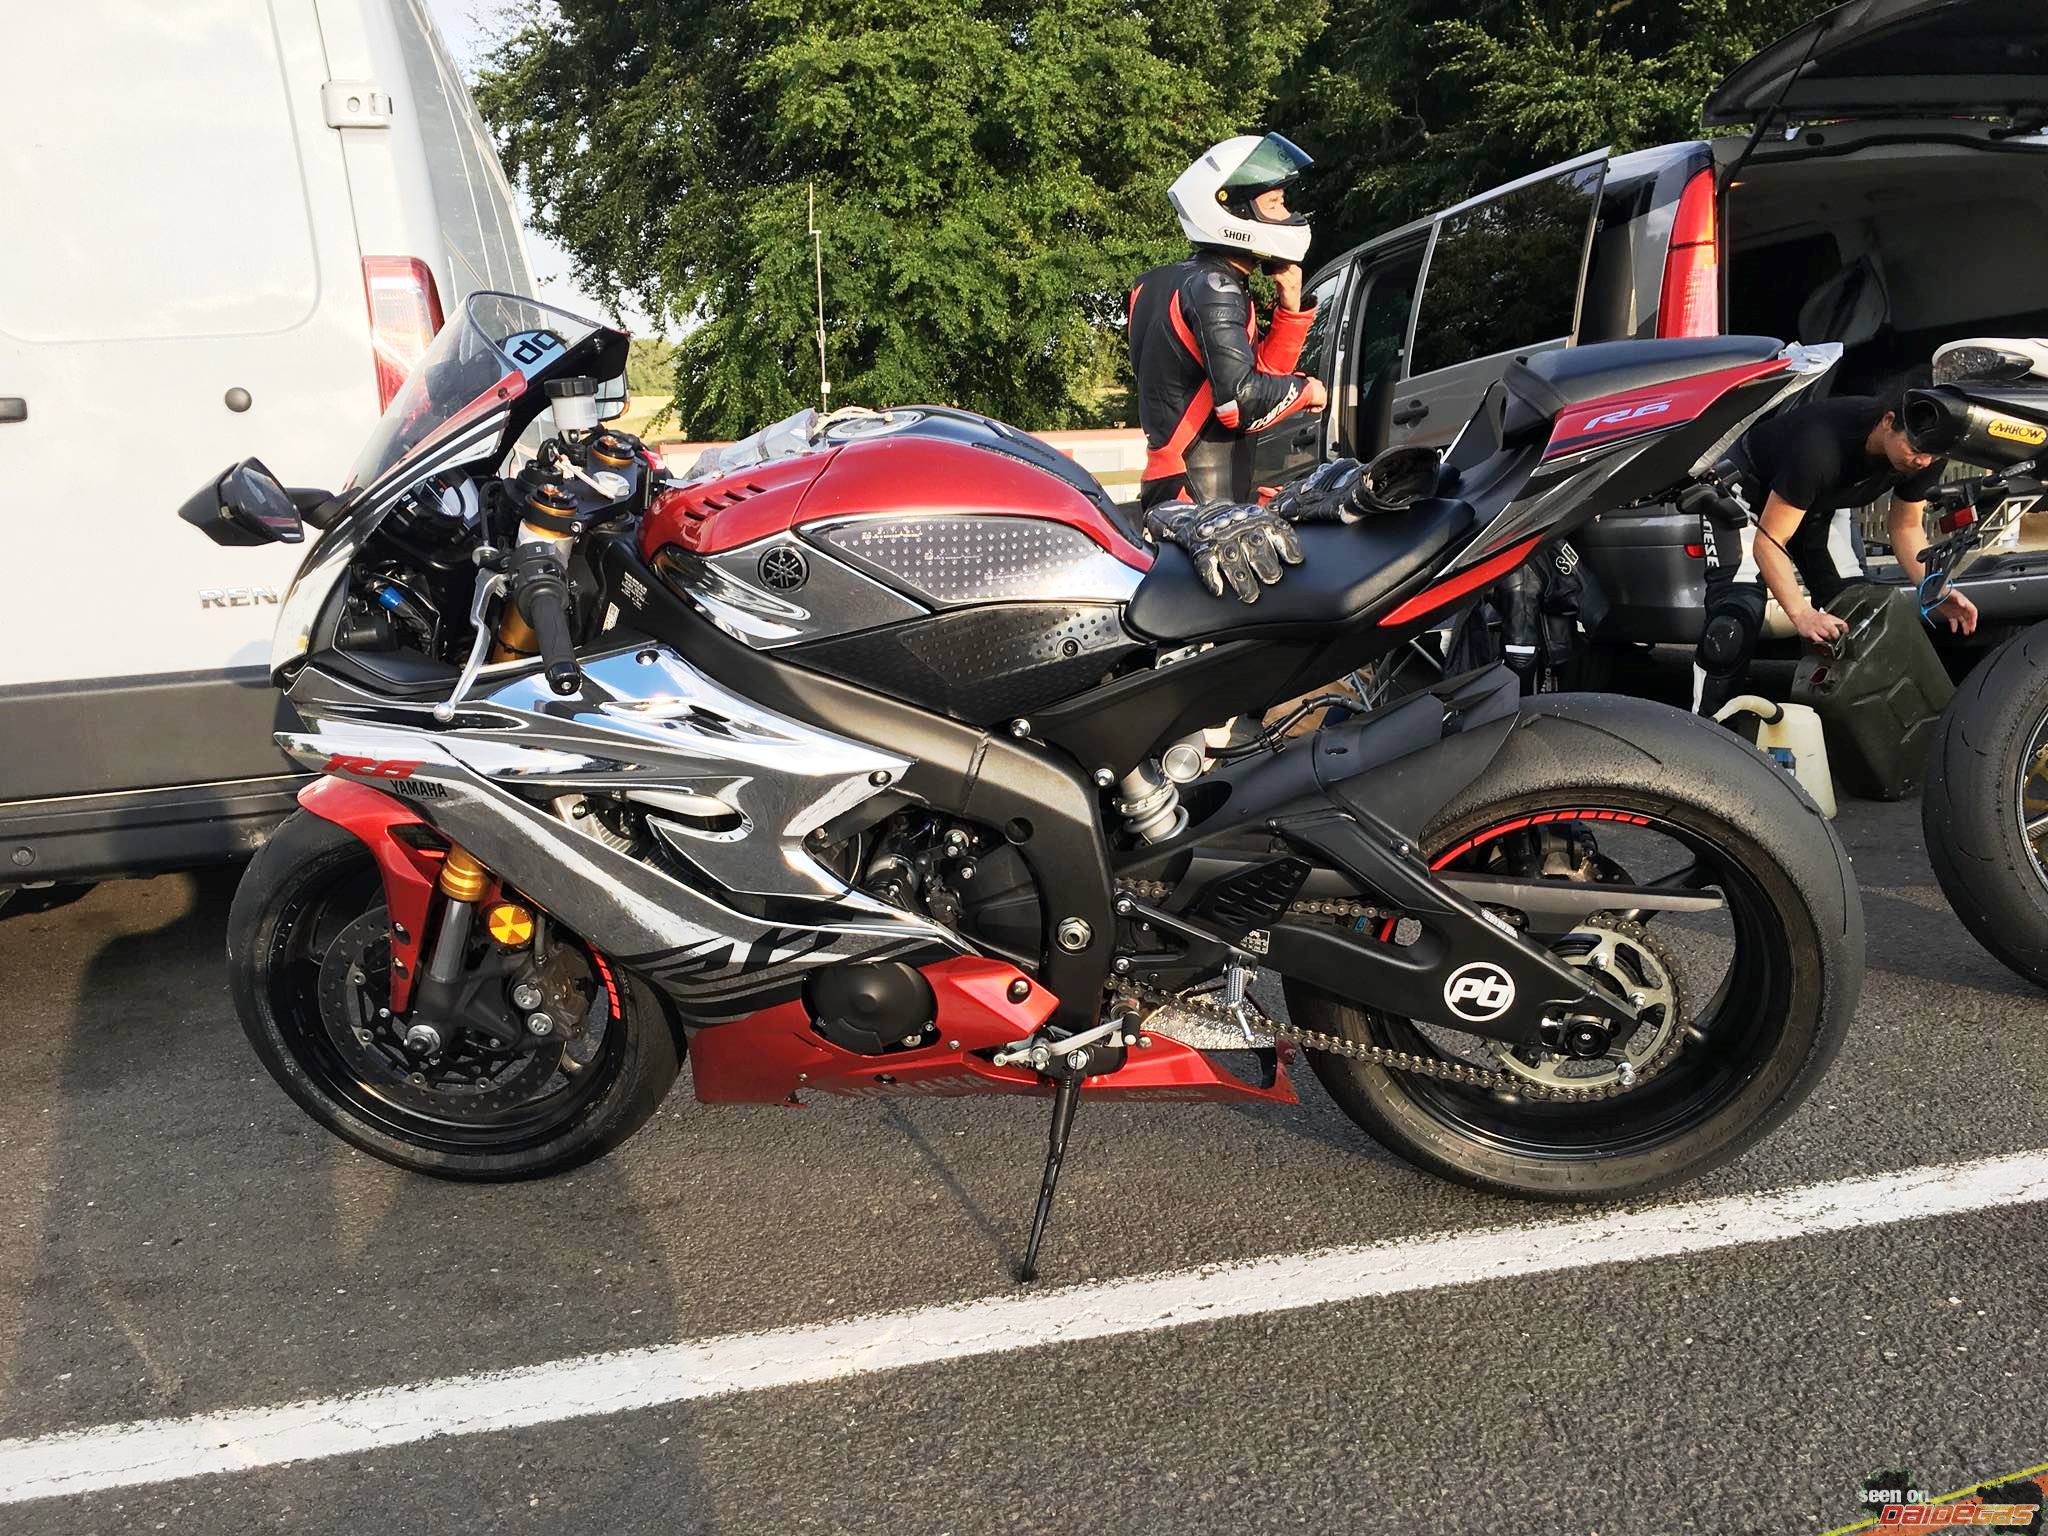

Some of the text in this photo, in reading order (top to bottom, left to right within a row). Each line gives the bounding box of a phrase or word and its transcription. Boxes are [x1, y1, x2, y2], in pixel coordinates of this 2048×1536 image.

[1223, 228, 1251, 243] SHOEI
[1583, 399, 1673, 431] R6
[1992, 422, 2043, 439] ARROW
[1702, 514, 1720, 568] NESE
[321, 752, 427, 780] R6
[390, 779, 448, 798] YAMAHA
